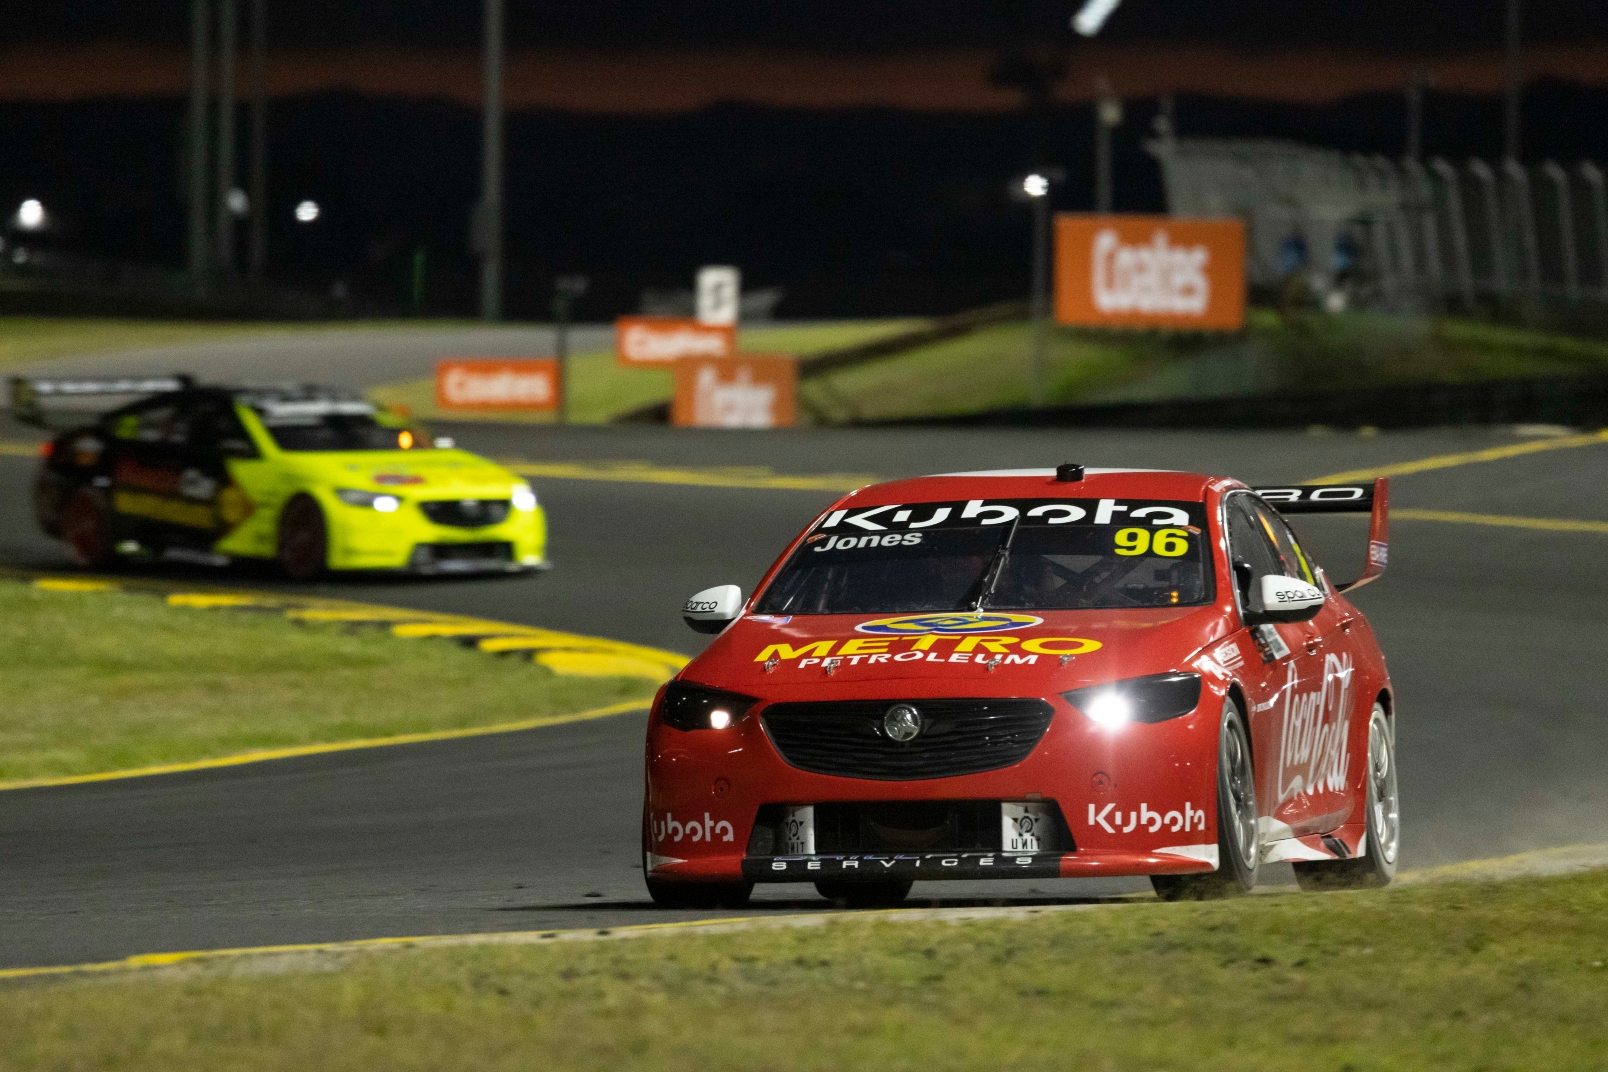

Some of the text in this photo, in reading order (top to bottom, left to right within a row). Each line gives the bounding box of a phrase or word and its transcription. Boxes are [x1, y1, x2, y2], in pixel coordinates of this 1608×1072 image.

[1092, 228, 1209, 315] Coates
[821, 498, 1190, 531] Kubota
[813, 532, 923, 553] Jones
[1113, 527, 1189, 557] 96
[753, 634, 1103, 662] METRO
[797, 650, 1039, 669] PETROLEUM
[651, 812, 735, 843] ubota
[1087, 801, 1206, 834] Kubota
[771, 856, 1033, 871] SERVICES
